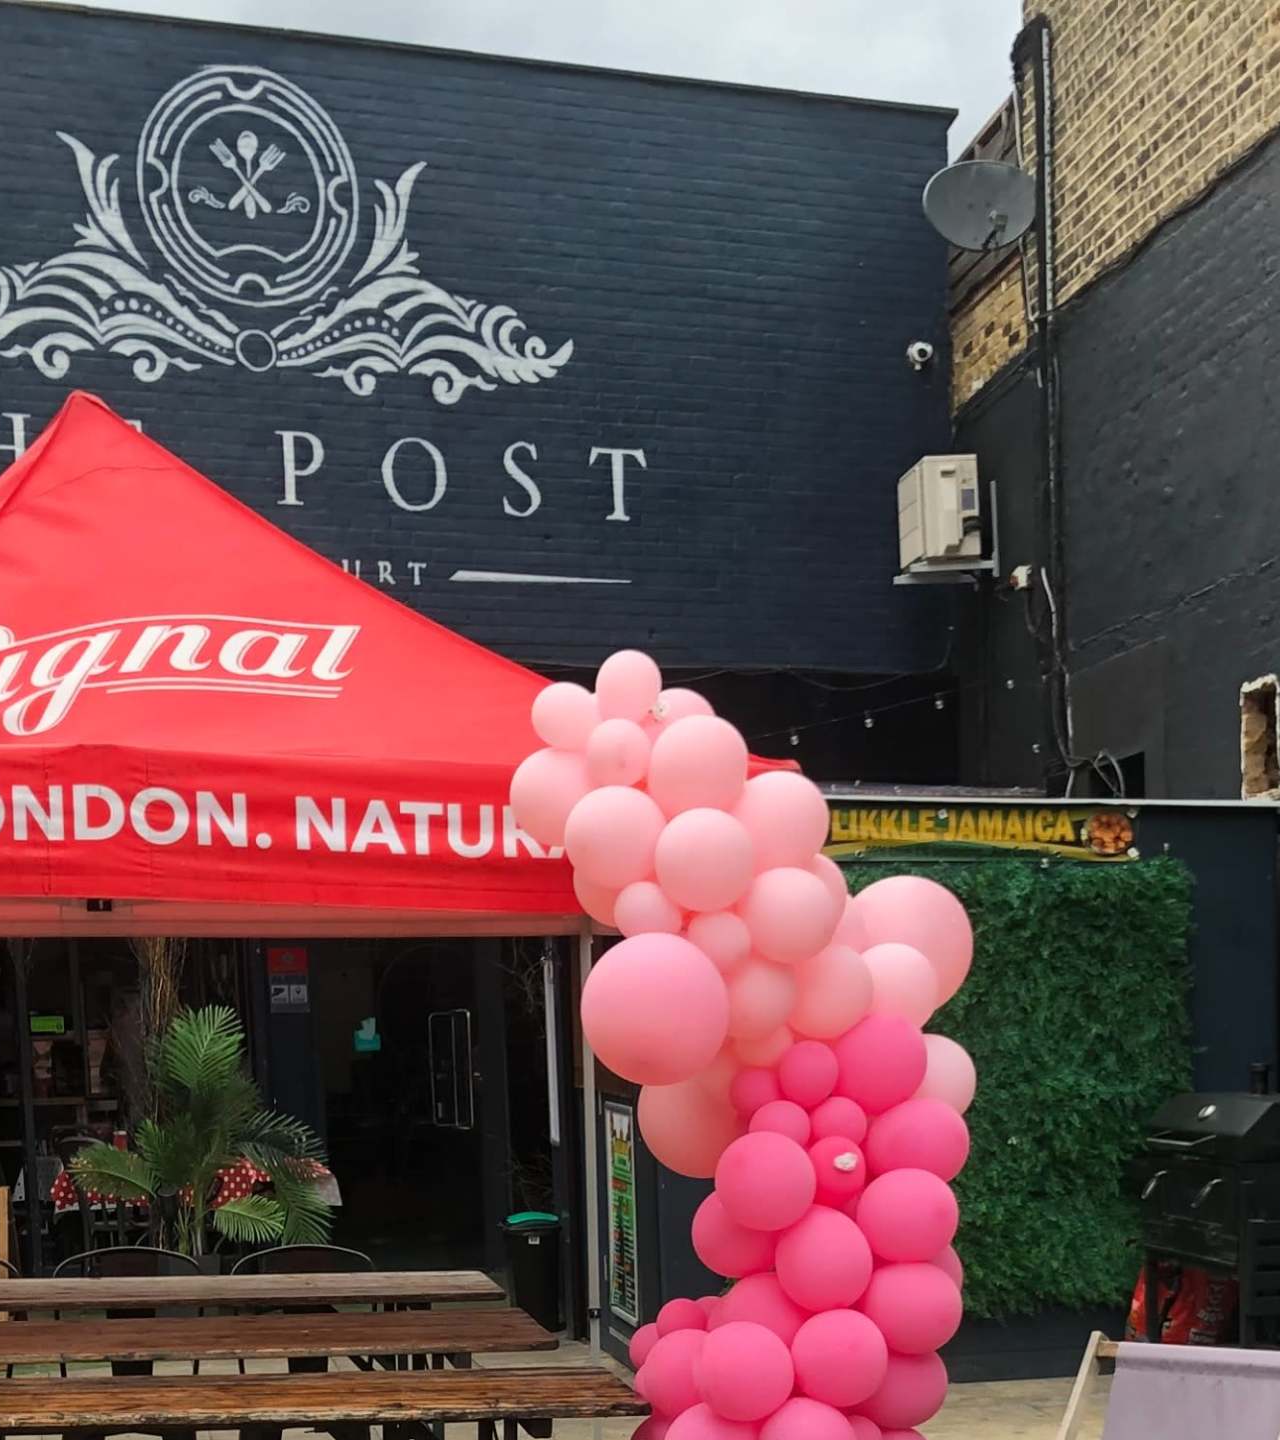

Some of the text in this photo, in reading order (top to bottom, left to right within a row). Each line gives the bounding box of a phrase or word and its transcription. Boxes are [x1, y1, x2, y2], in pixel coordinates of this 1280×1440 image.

[275, 430, 646, 522] POST
[295, 796, 567, 859] NATUR
[830, 809, 1075, 842] LIKKLE JAMAICA
